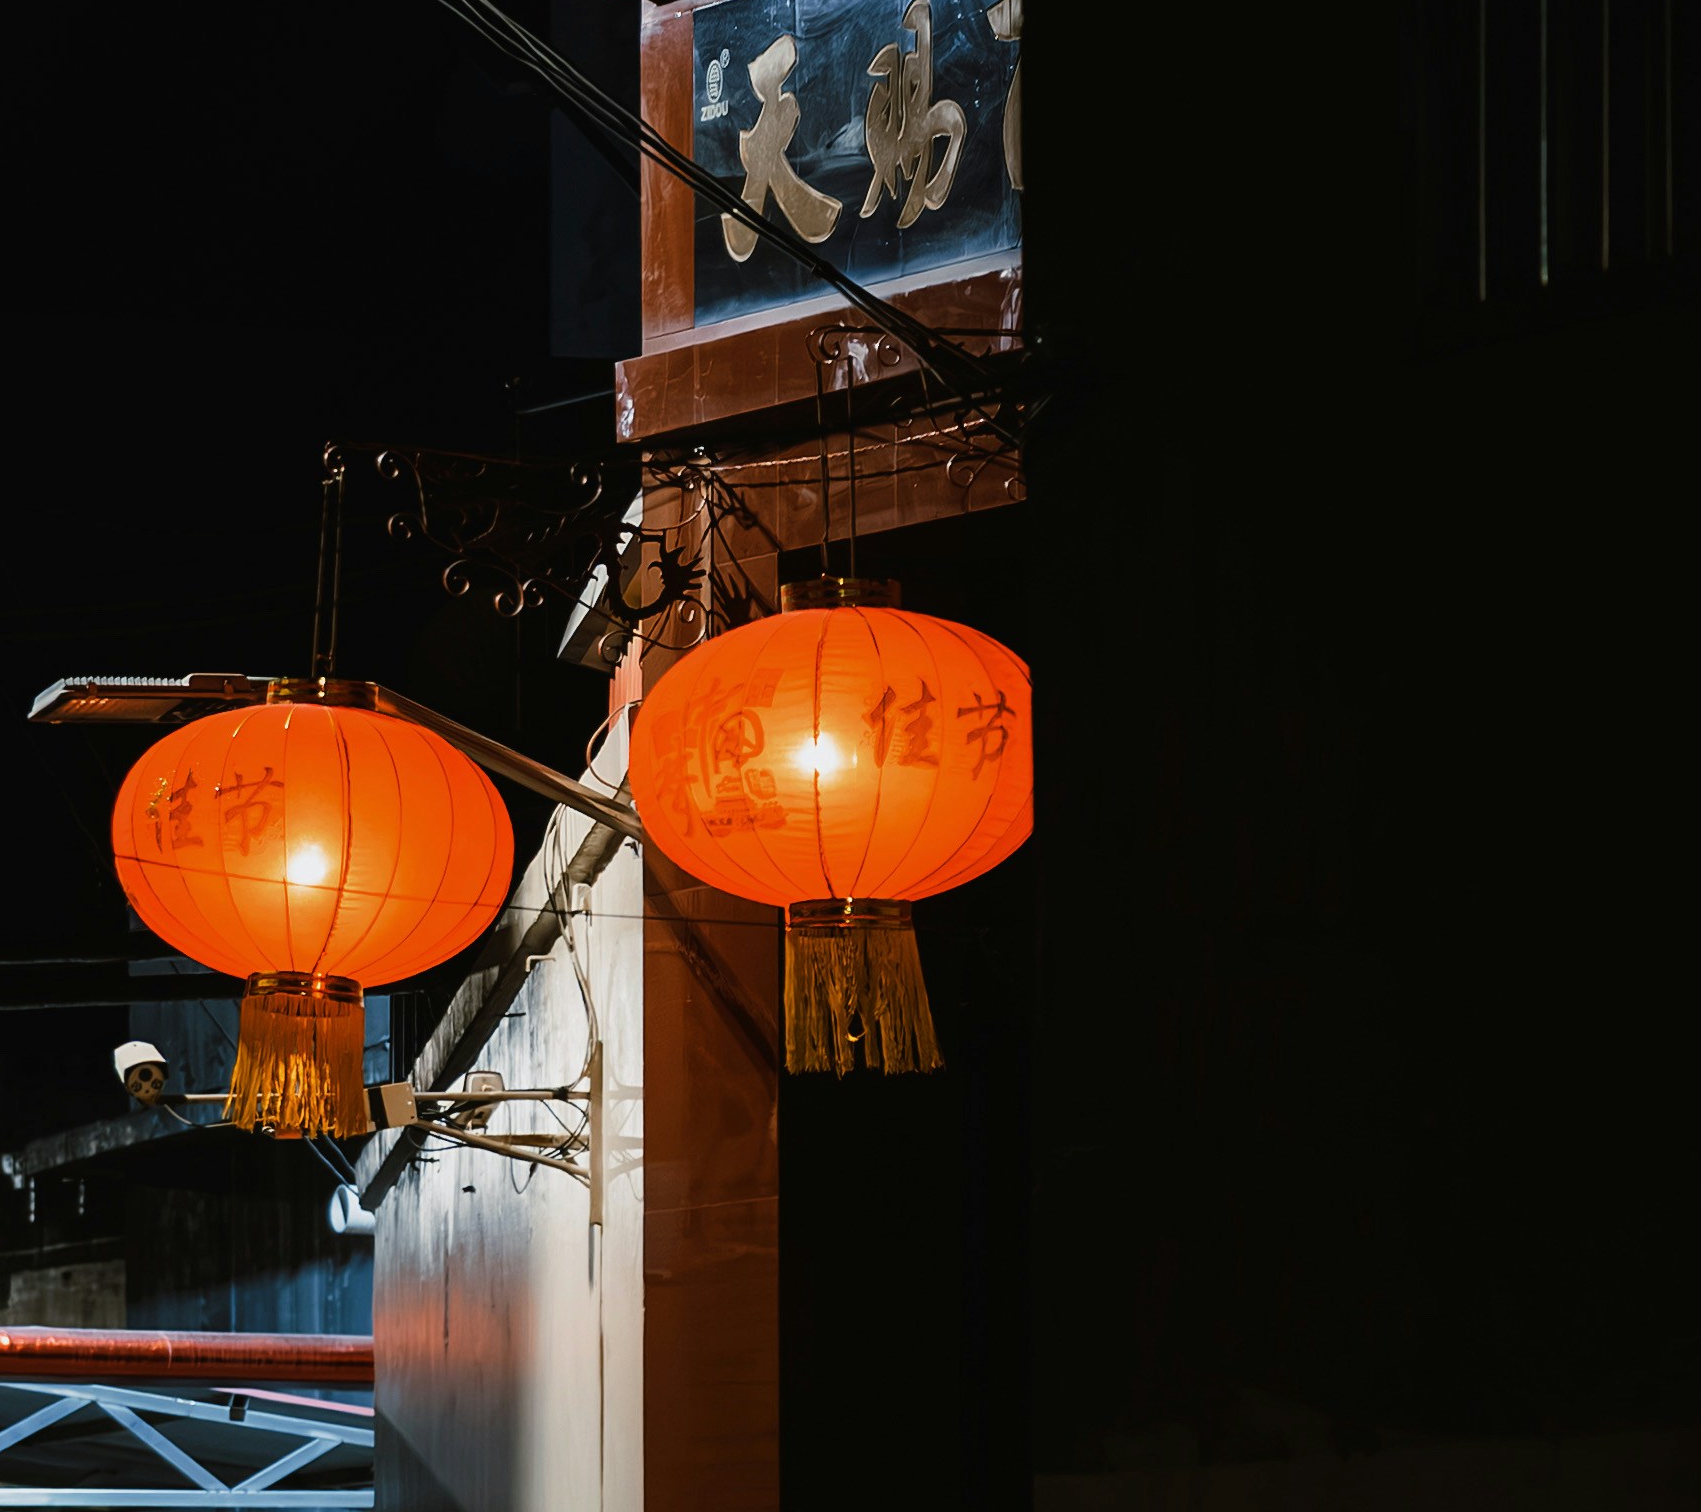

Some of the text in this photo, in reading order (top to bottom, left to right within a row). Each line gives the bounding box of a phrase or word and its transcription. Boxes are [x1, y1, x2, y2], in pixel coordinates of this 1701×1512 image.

[701, 100, 729, 122] ZIDOU
[861, 675, 1017, 781] 佳节
[145, 767, 285, 856] 佳节
